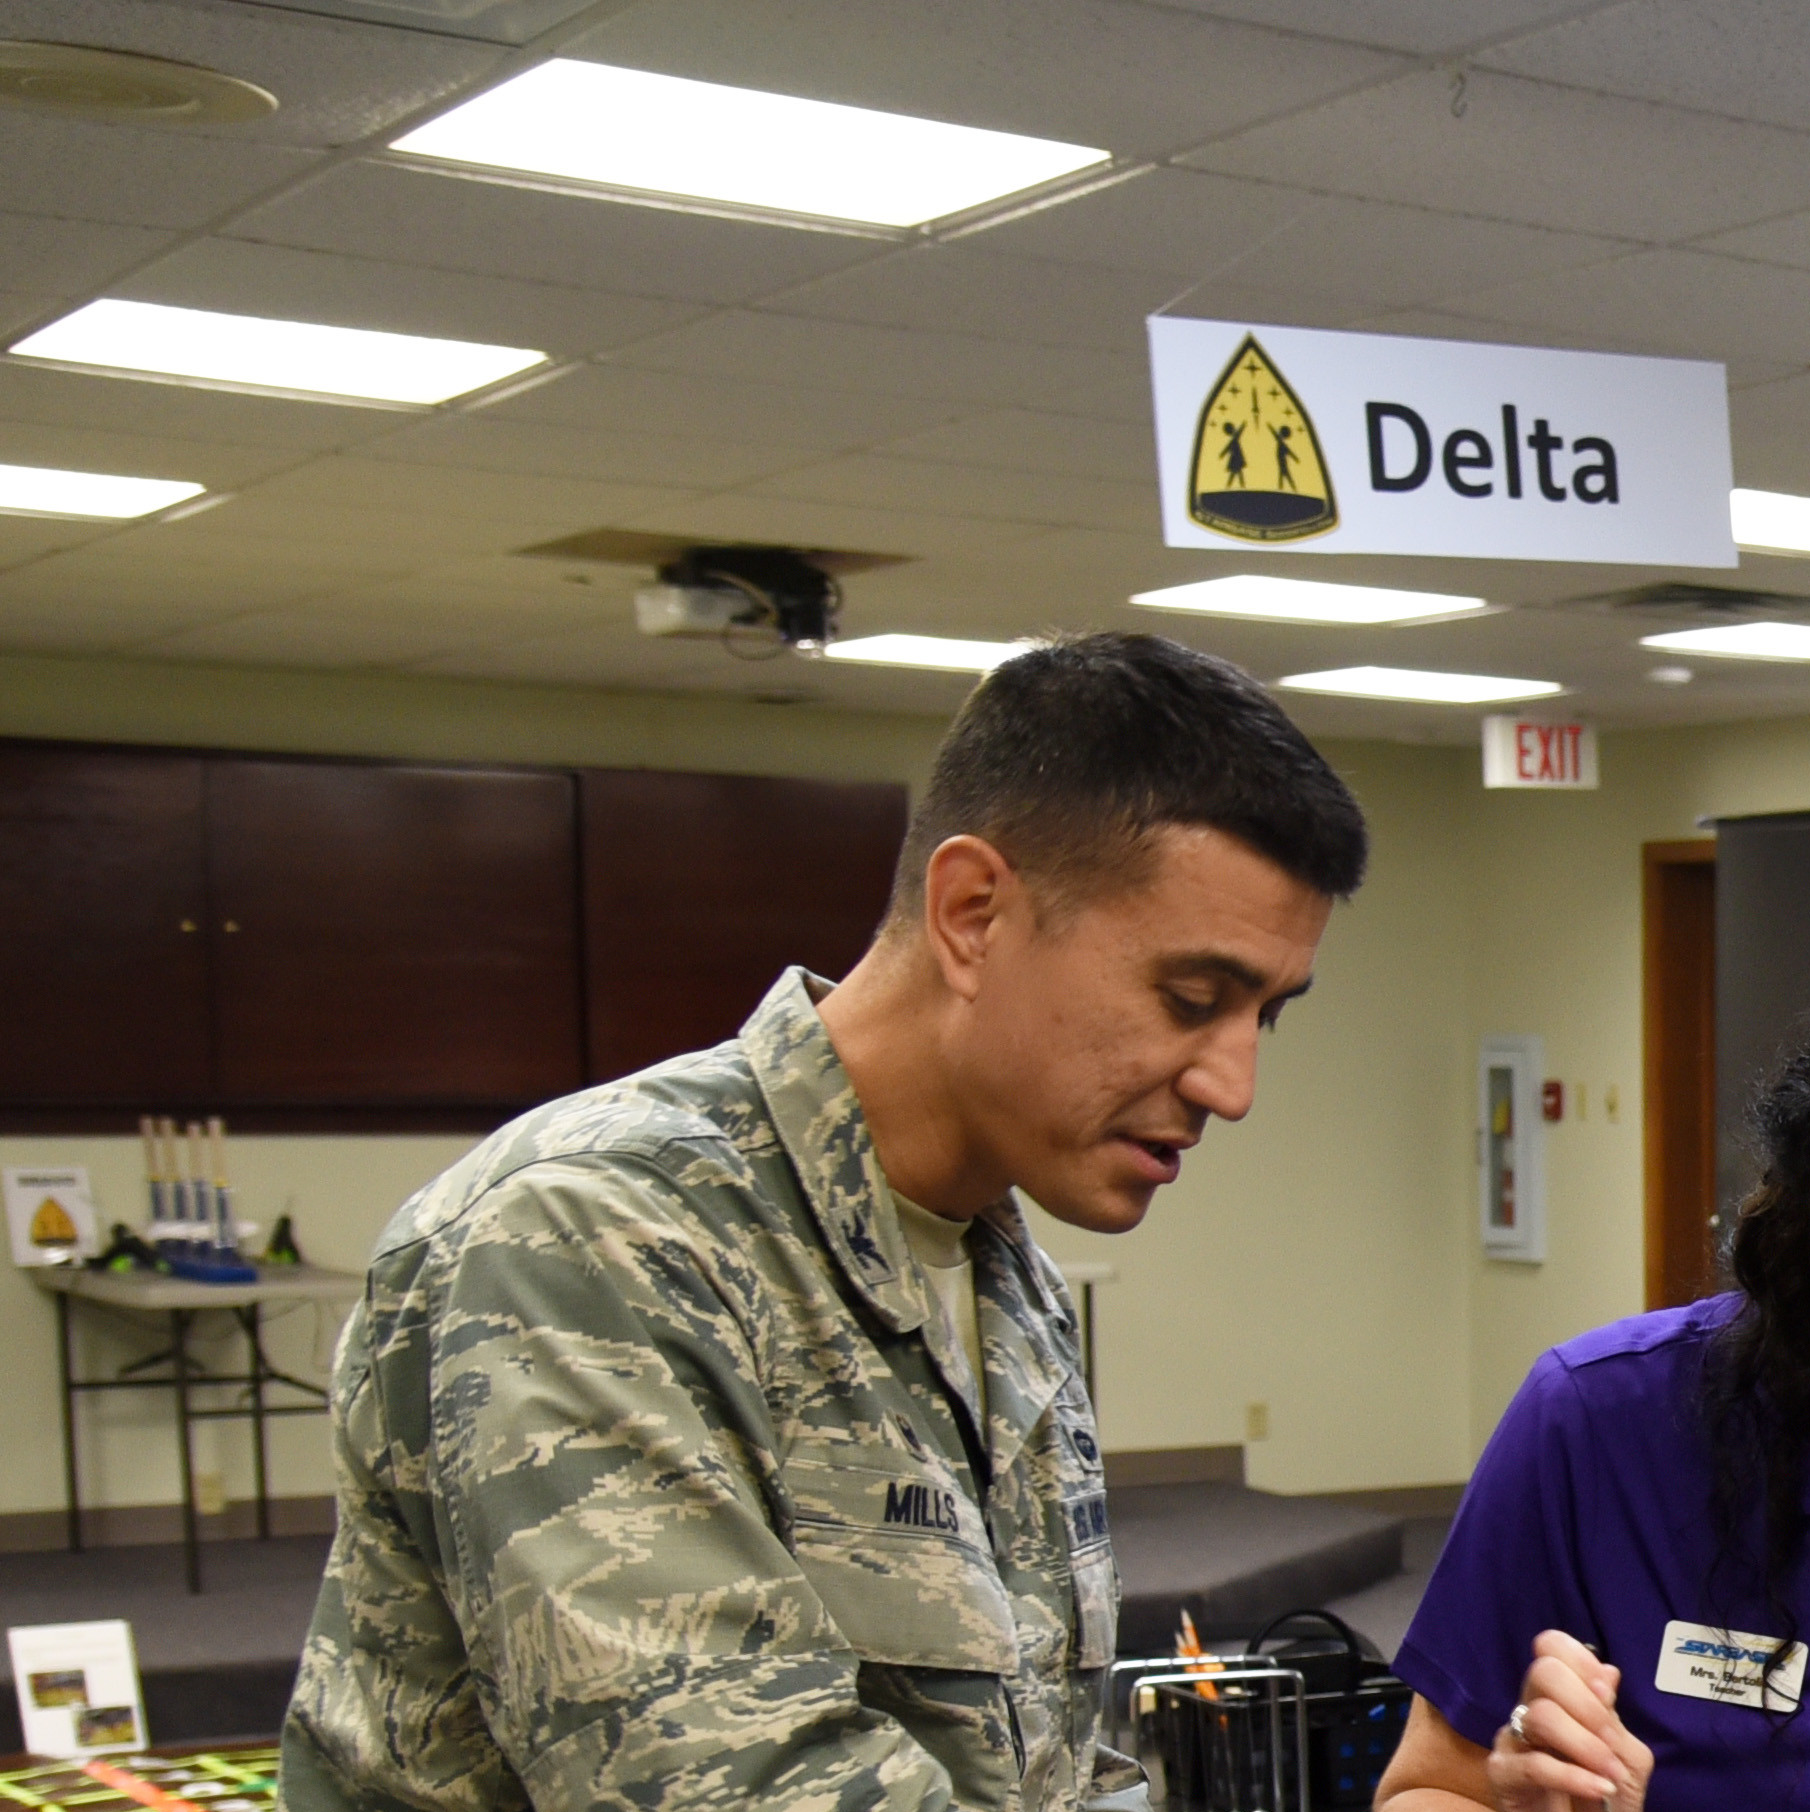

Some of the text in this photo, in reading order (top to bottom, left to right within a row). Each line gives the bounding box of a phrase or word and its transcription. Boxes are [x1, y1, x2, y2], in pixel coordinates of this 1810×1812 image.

[1365, 401, 1620, 505] Delta
[1515, 723, 1584, 782] EXIT
[884, 1481, 960, 1532] MILLS
[1690, 1665, 1719, 1681] Mrs.
